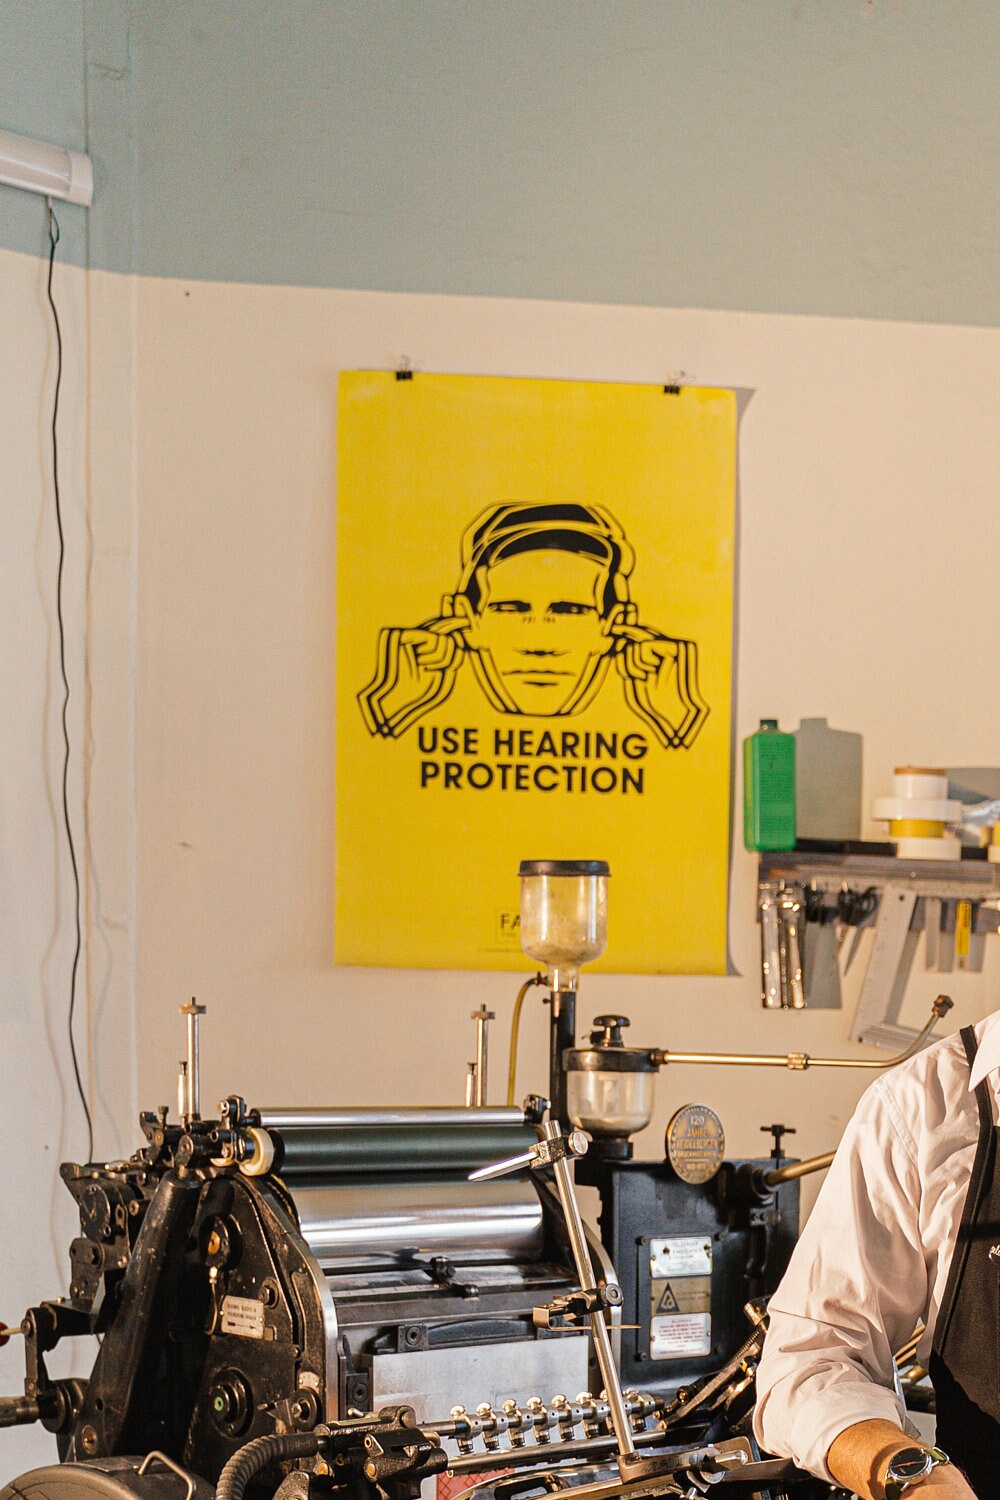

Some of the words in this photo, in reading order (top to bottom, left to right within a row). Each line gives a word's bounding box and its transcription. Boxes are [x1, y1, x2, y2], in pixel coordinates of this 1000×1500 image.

[417, 725, 479, 755] USE
[494, 728, 650, 761] HEARING
[420, 762, 645, 794] PROTECTION
